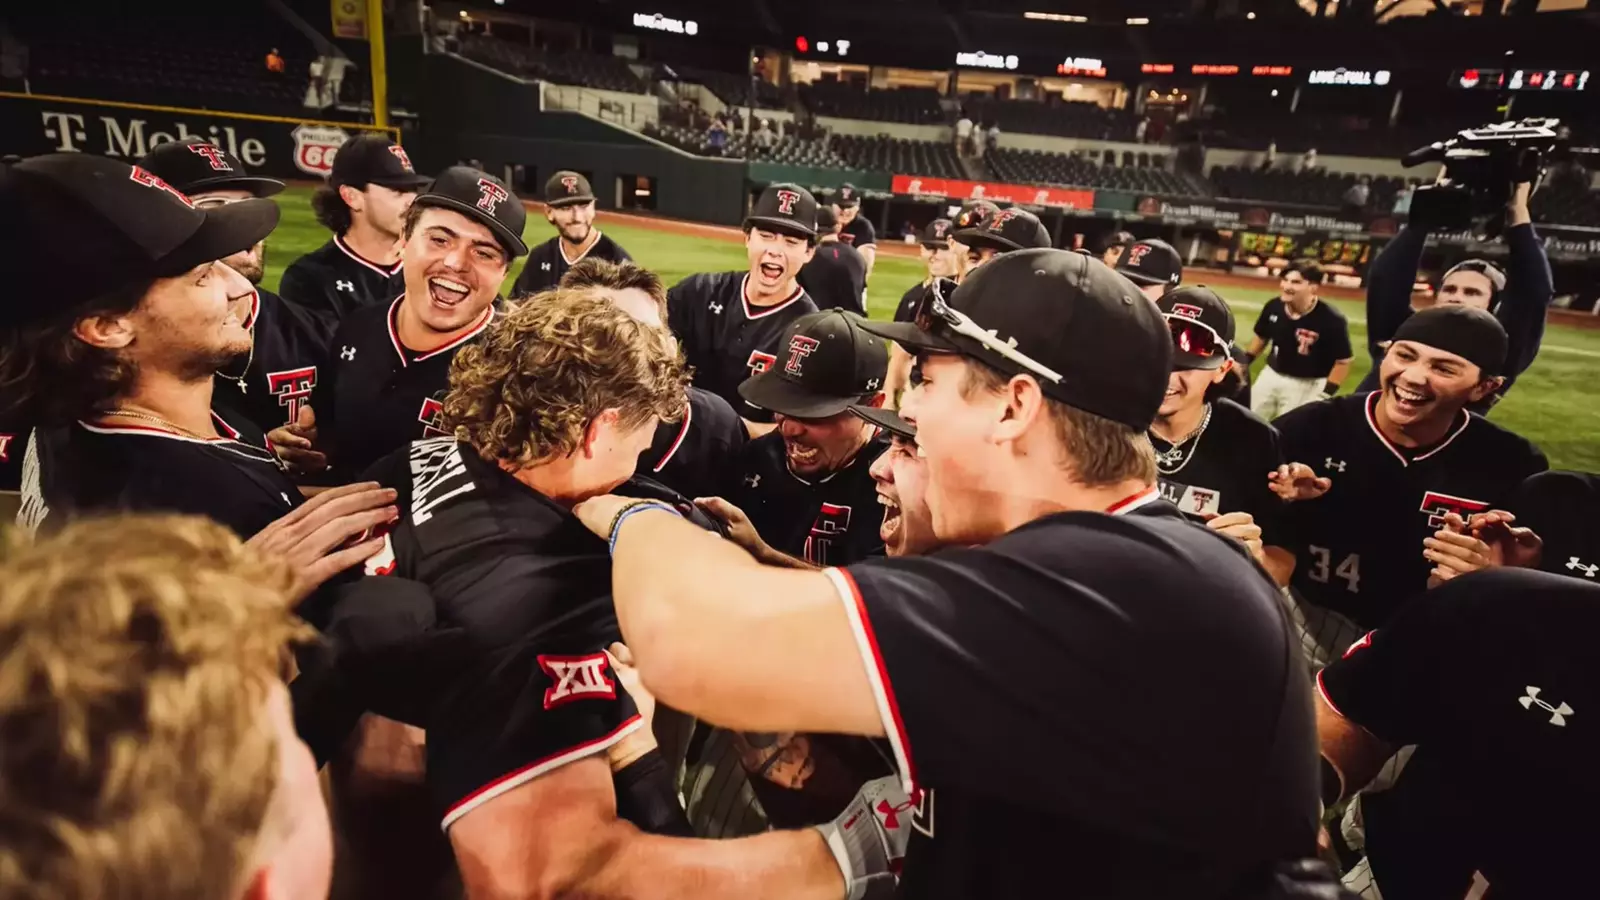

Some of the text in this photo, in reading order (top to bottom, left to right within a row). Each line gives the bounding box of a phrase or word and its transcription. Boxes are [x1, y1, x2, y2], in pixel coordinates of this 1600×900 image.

[42, 111, 87, 153] T
[305, 146, 339, 168] 66
[1309, 545, 1361, 594] 34
[545, 657, 613, 702] XII
